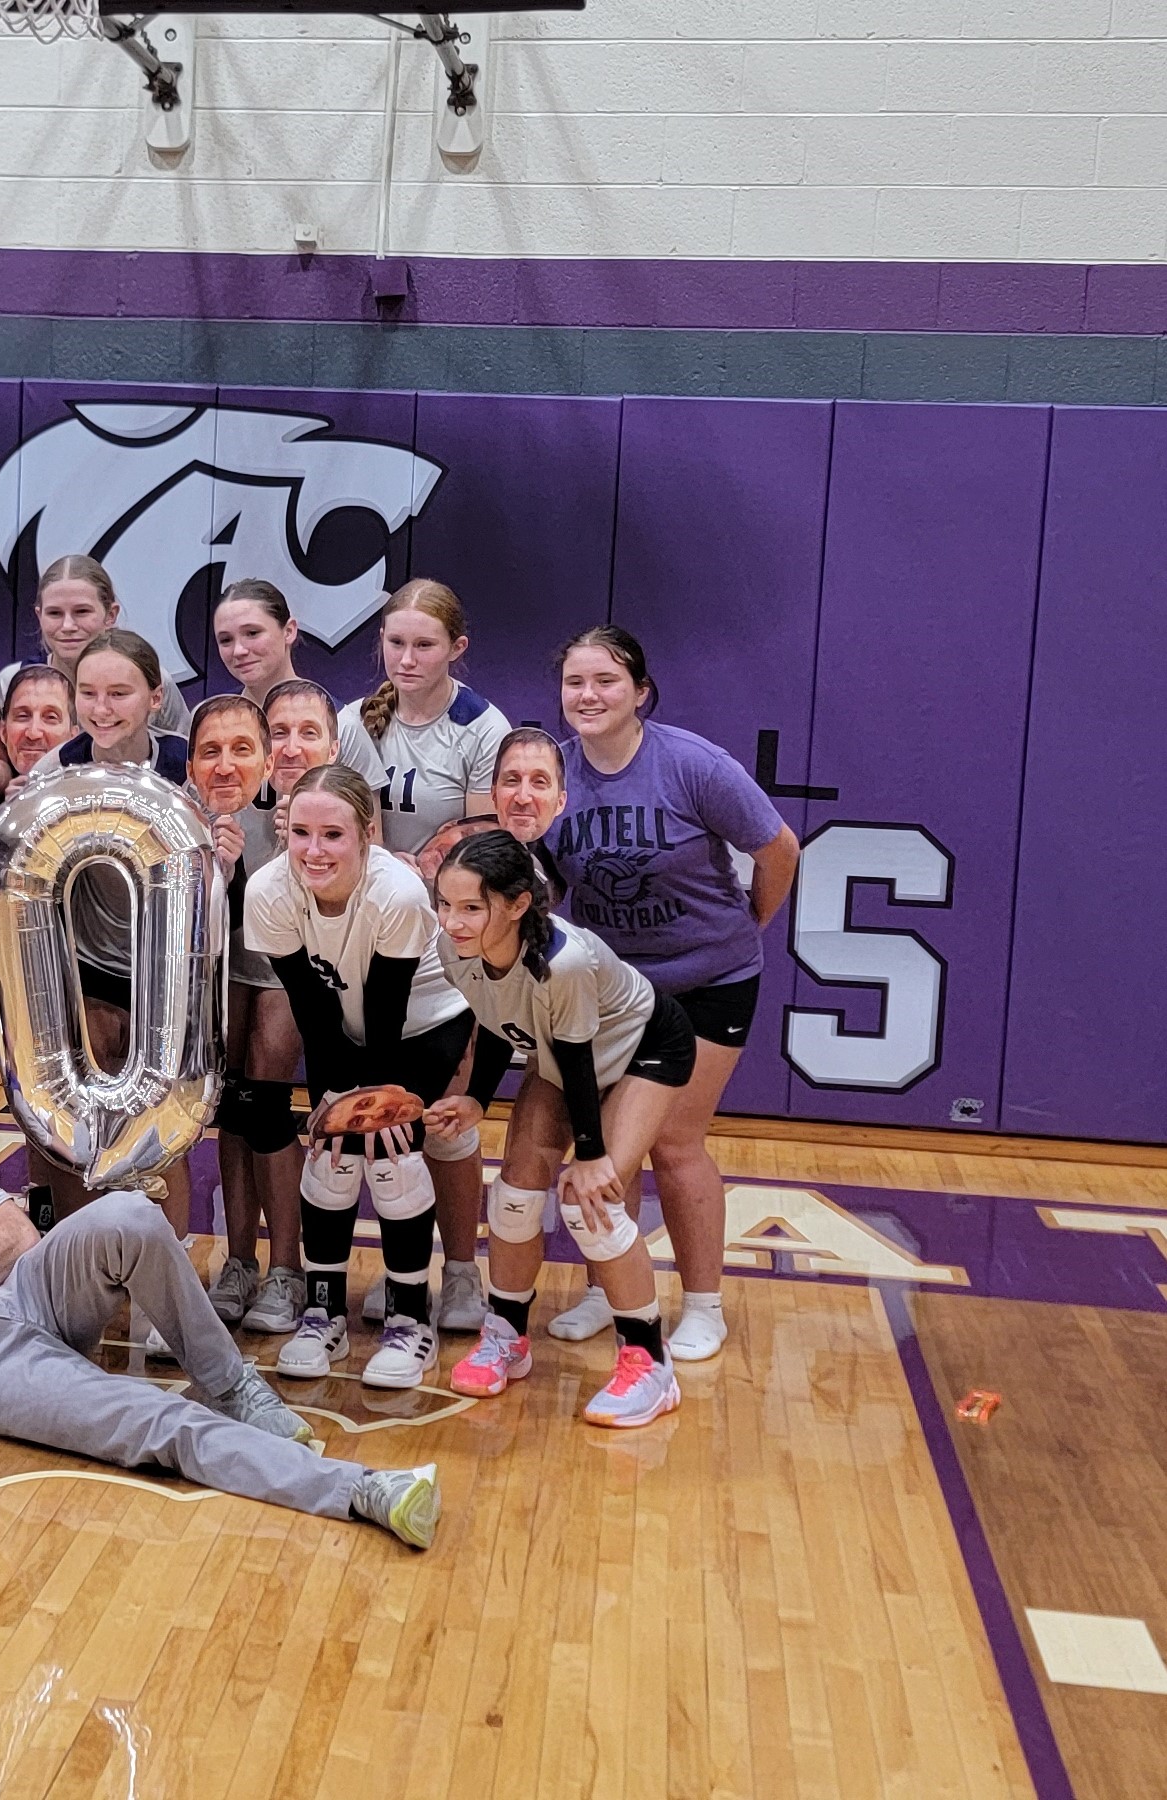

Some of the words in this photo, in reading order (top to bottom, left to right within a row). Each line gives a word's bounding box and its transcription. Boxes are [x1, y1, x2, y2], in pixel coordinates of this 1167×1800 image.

[380, 765, 417, 813] 11
[556, 804, 676, 862] AXTELL
[576, 897, 688, 930] OLLEYBALL
